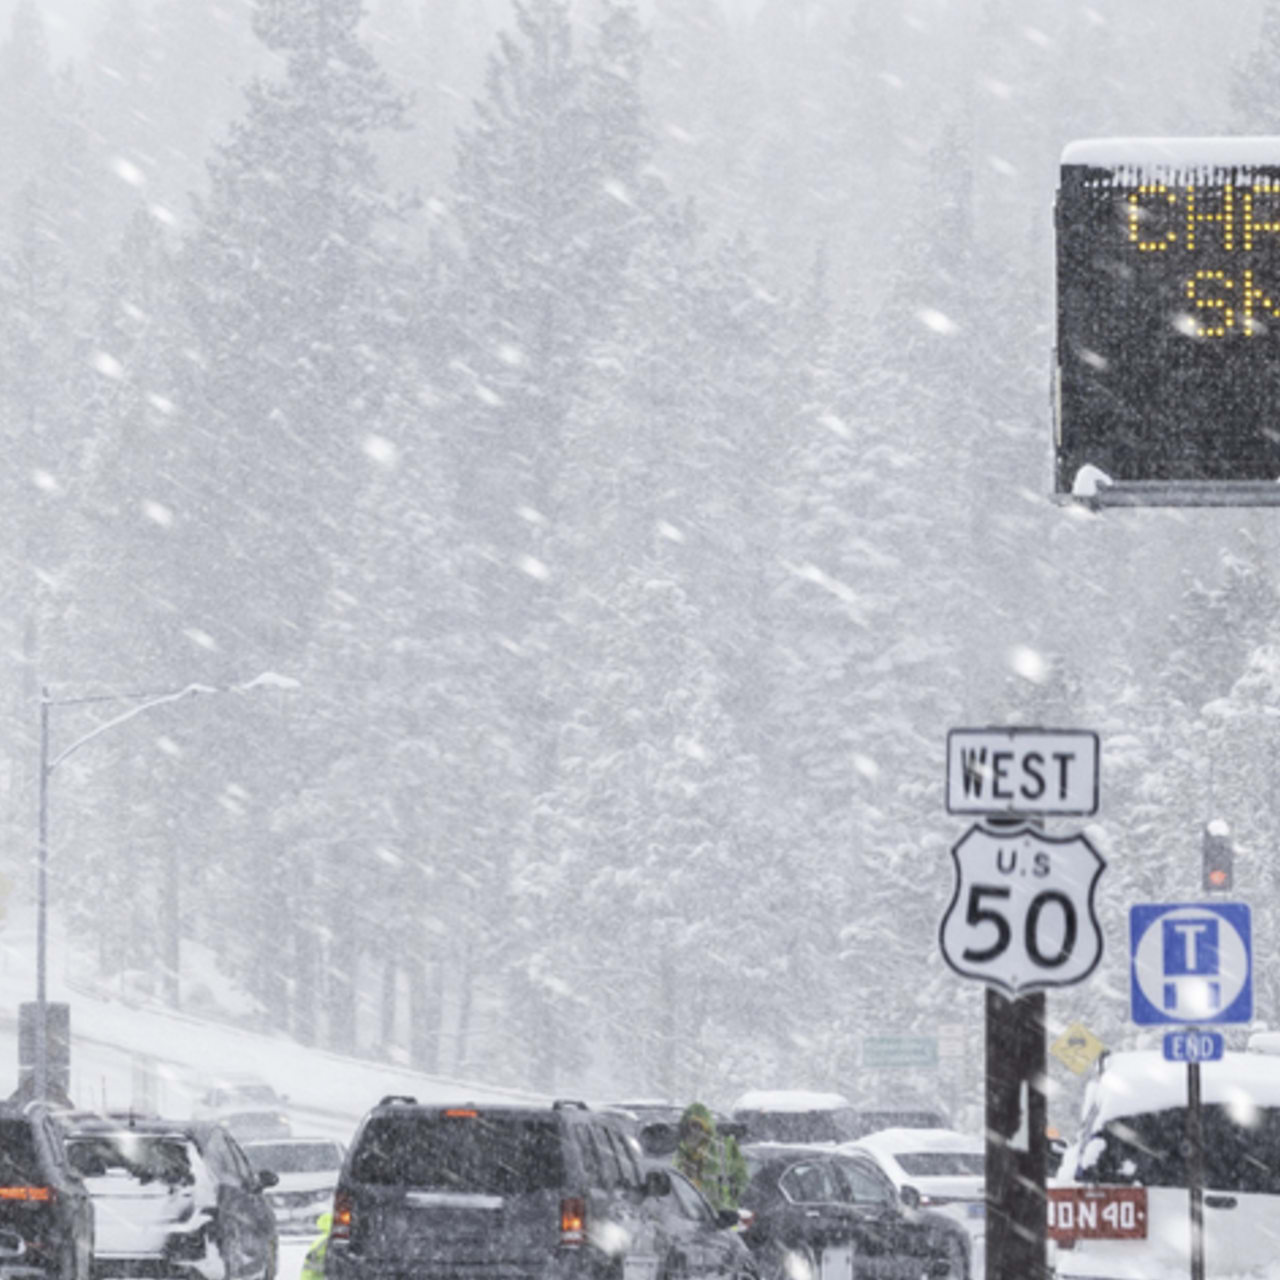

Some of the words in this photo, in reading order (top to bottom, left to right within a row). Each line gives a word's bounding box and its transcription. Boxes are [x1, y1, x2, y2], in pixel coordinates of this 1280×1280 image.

[960, 746, 1076, 801] WEST
[961, 883, 1078, 970] 50
[1171, 1035, 1215, 1061] END
